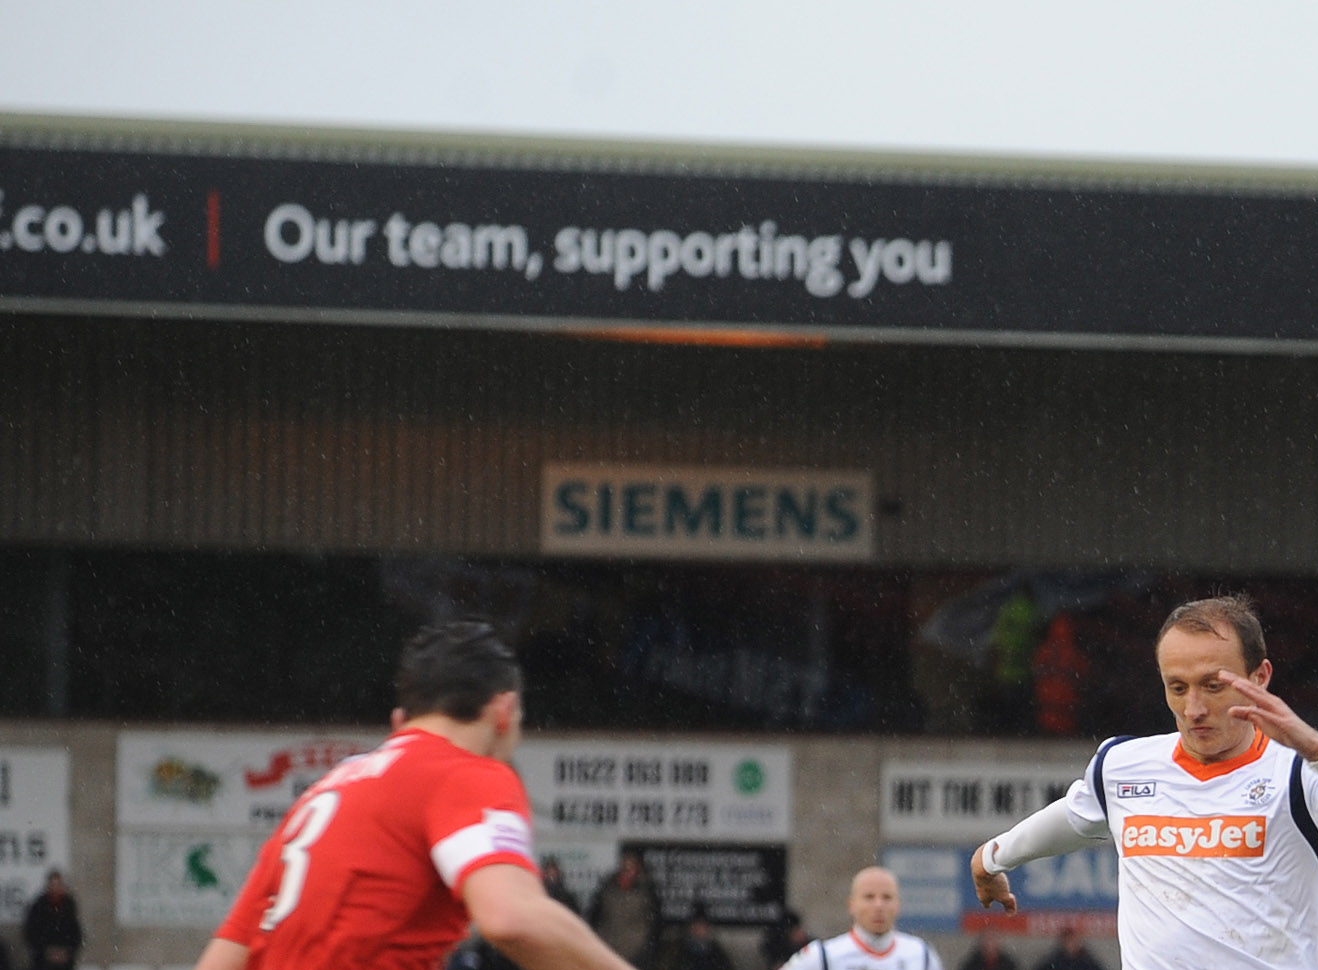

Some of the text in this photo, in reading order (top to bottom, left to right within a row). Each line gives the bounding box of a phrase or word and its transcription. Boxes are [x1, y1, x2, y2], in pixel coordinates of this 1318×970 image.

[264, 203, 953, 299] Our team, supporting you
[555, 480, 858, 542] SIEMENS
[1120, 785, 1152, 797] FILA
[259, 790, 341, 932] 3
[1124, 818, 1264, 855] easyJet
